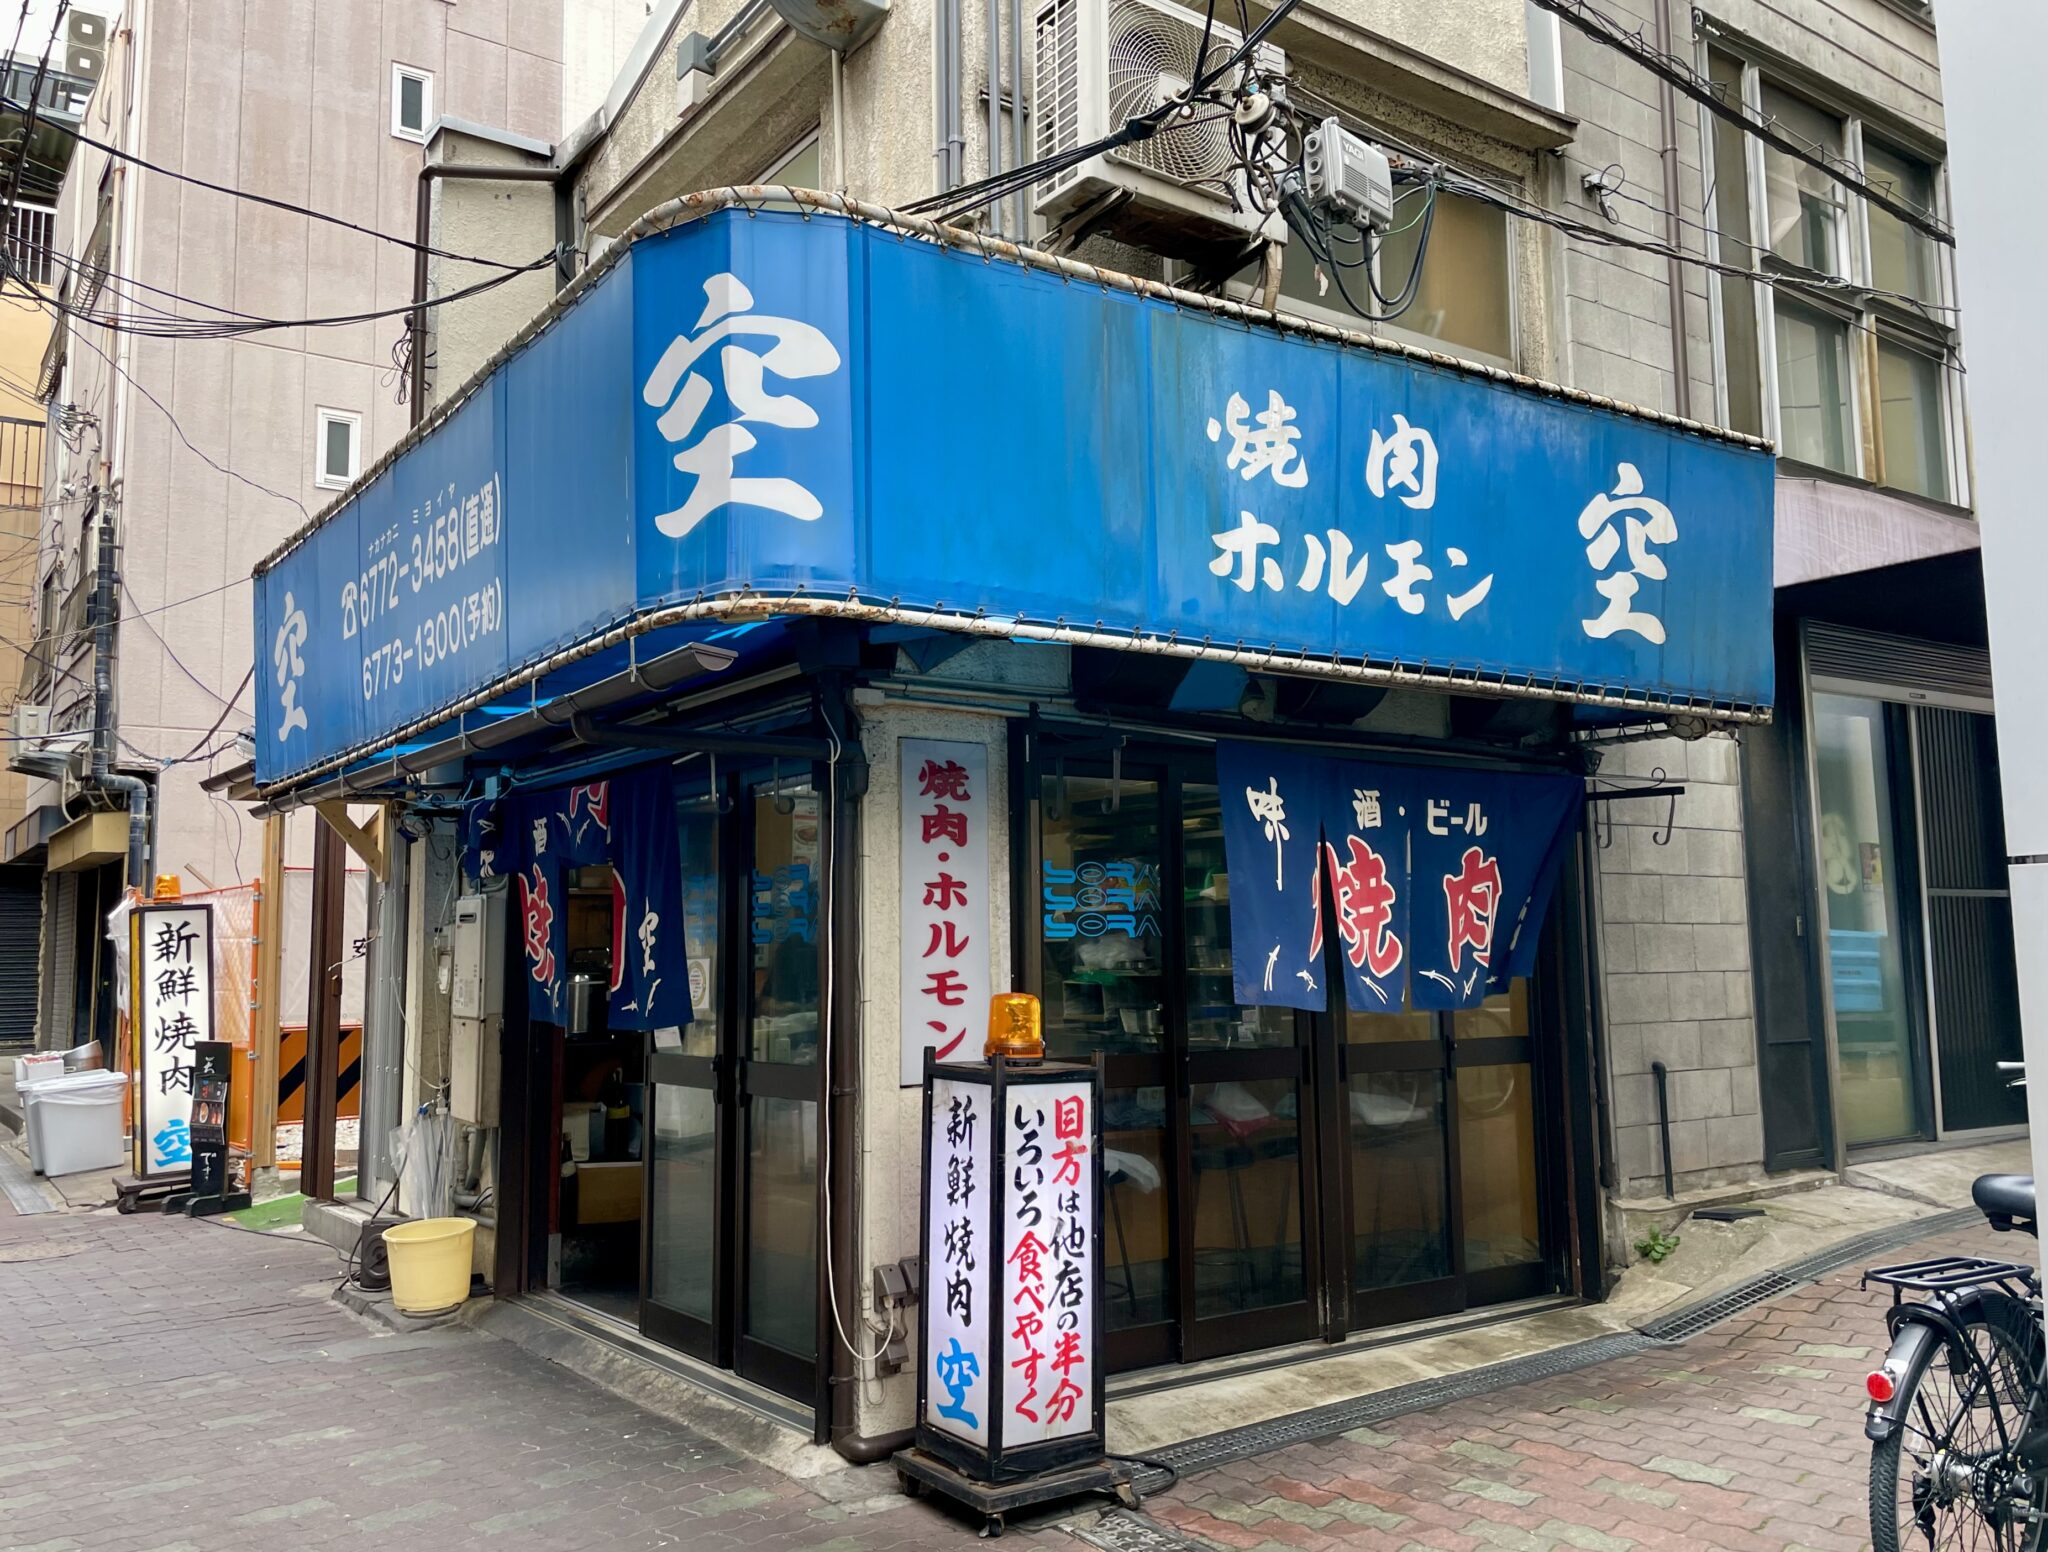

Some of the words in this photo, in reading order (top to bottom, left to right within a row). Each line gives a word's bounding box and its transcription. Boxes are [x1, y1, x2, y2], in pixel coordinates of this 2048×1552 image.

[643, 272, 841, 538] 空
[1206, 389, 1439, 509] 焼肉
[1208, 511, 1494, 622] ホルモン
[1578, 462, 1678, 645] 空
[274, 591, 308, 742] 空
[1246, 776, 1290, 892] 味
[151, 920, 200, 1097] 新鮮焼肉
[153, 1118, 192, 1168] 空
[944, 1095, 977, 1328] 新鮮焼肉
[1007, 1103, 1049, 1424] いろいろ食べやすく
[1045, 1097, 1089, 1425] 目方は他店の半分
[936, 1336, 980, 1430] 空
